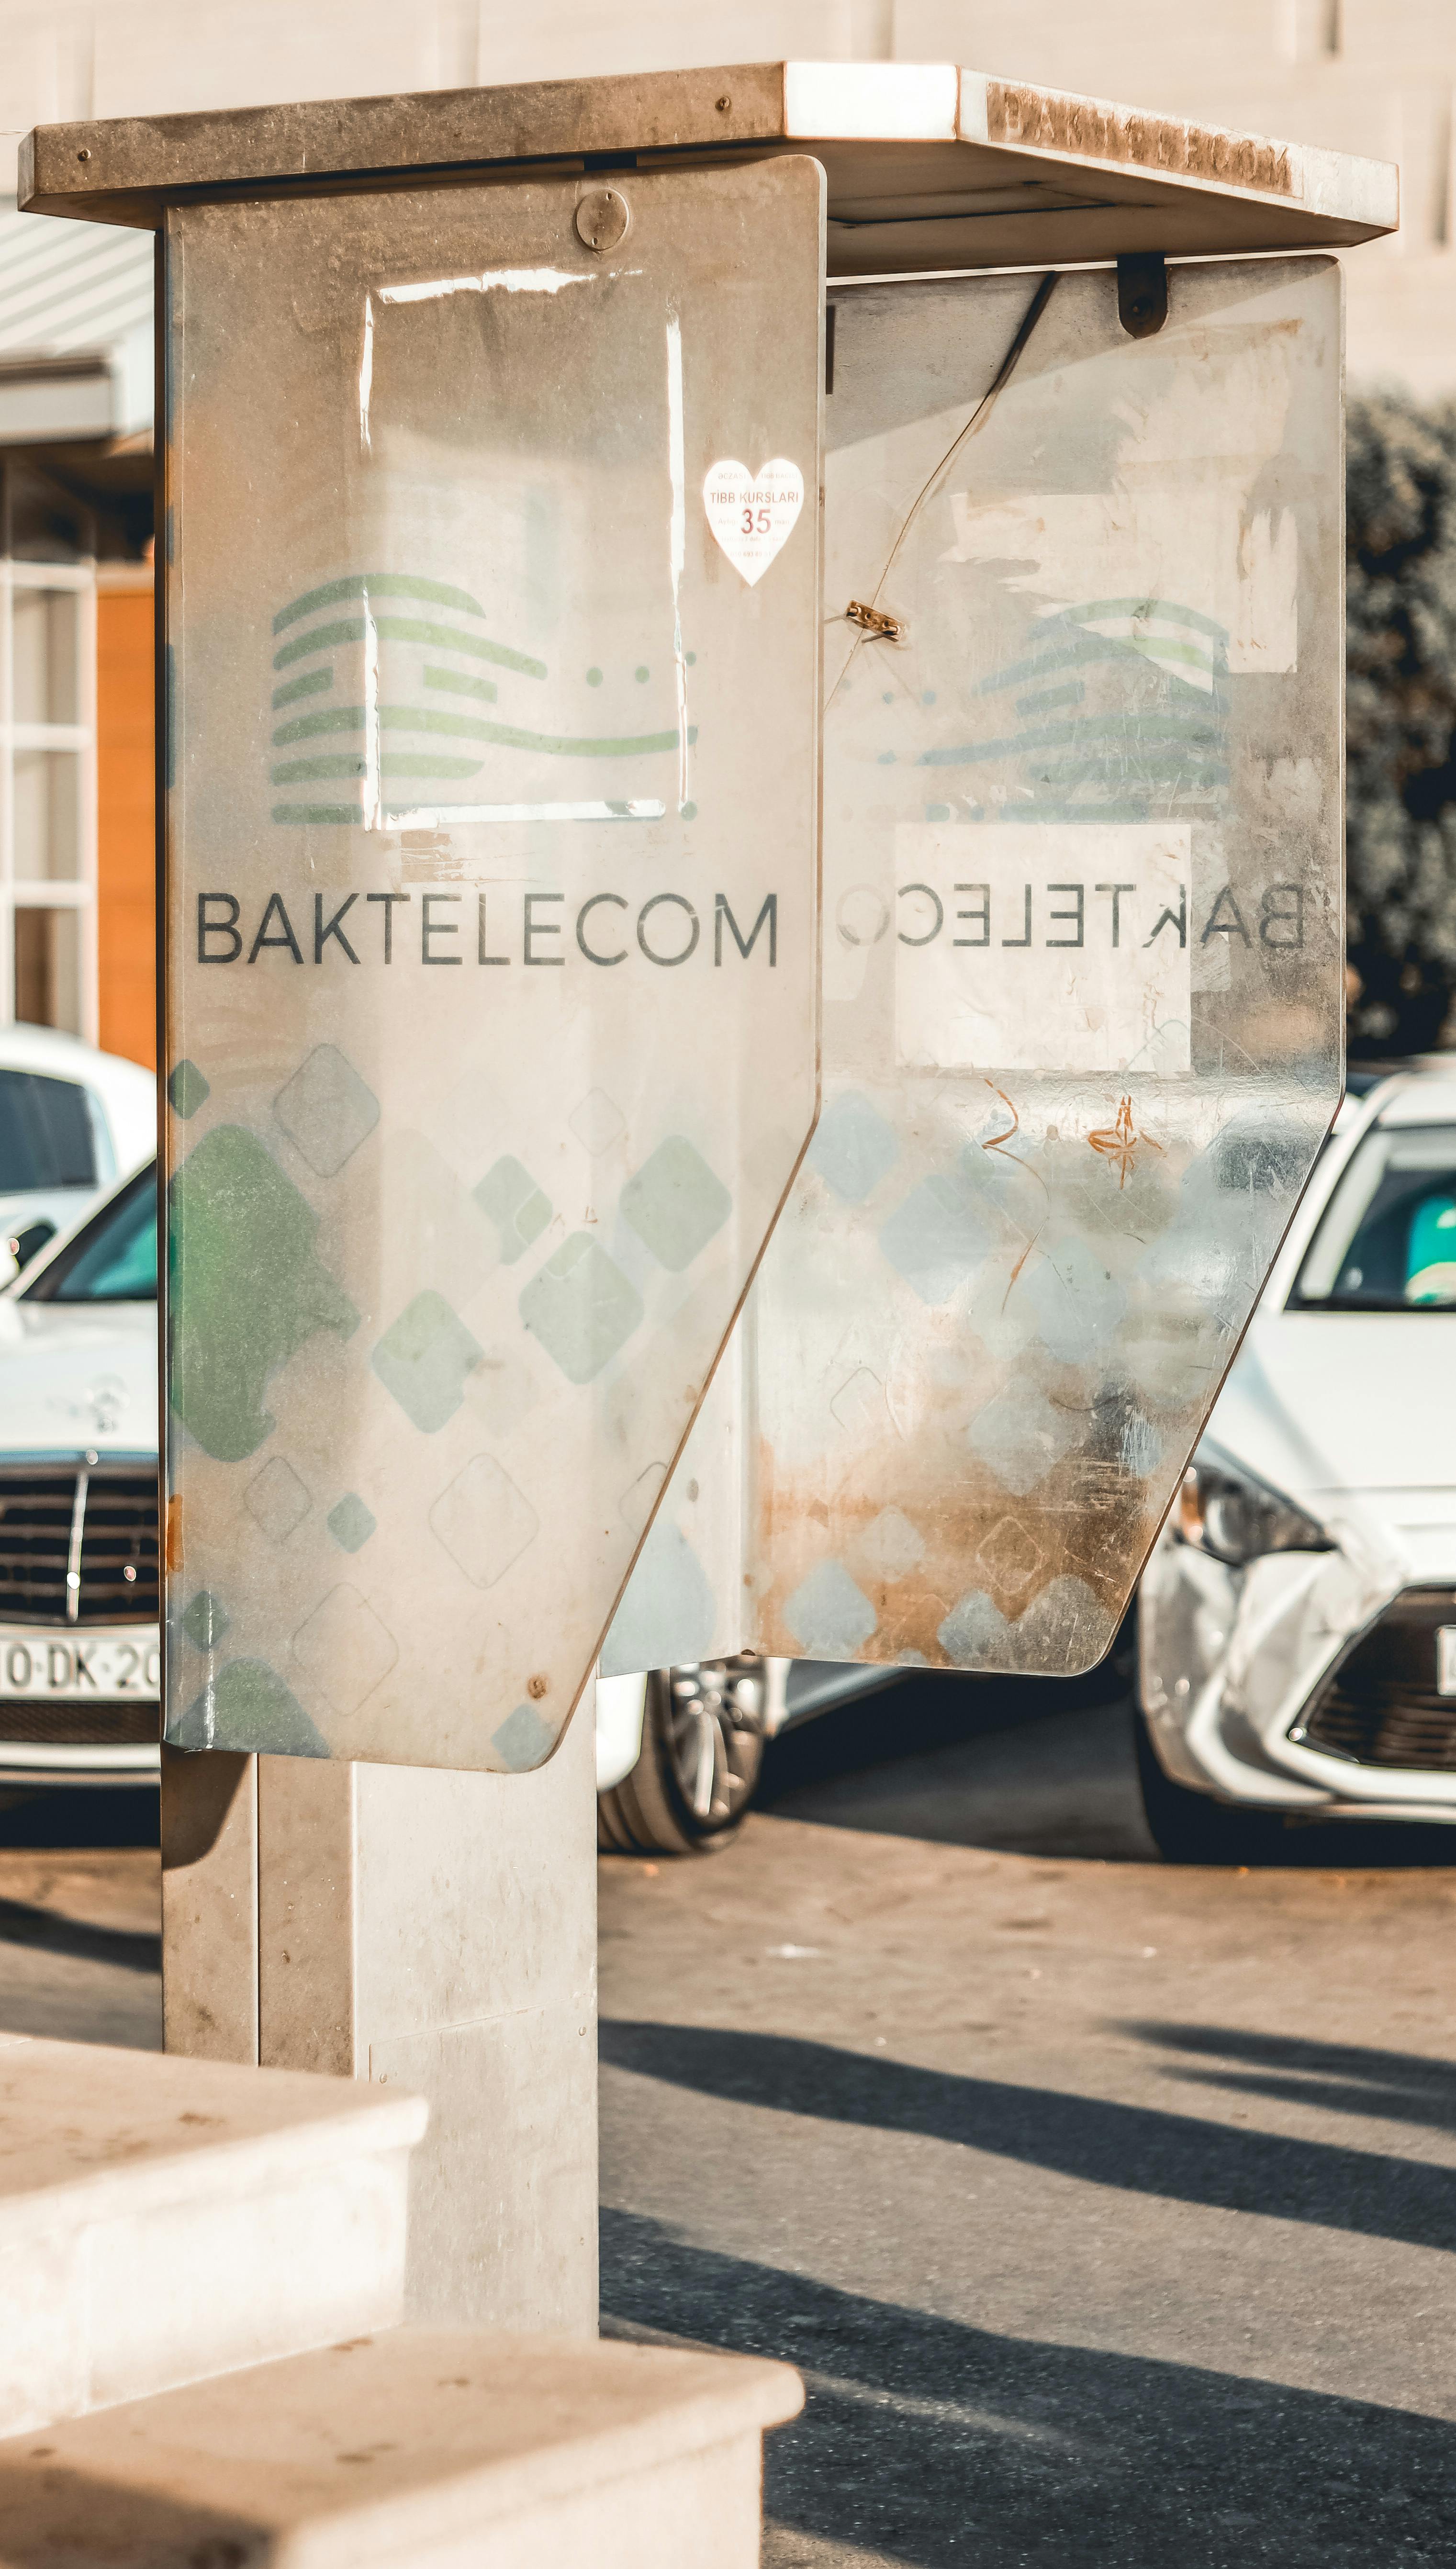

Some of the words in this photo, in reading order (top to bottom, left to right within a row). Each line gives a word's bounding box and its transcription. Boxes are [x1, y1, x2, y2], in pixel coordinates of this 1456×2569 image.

[740, 492, 798, 503] KURSLARI
[741, 508, 771, 534] 35
[197, 892, 778, 967] BAKTELECOM
